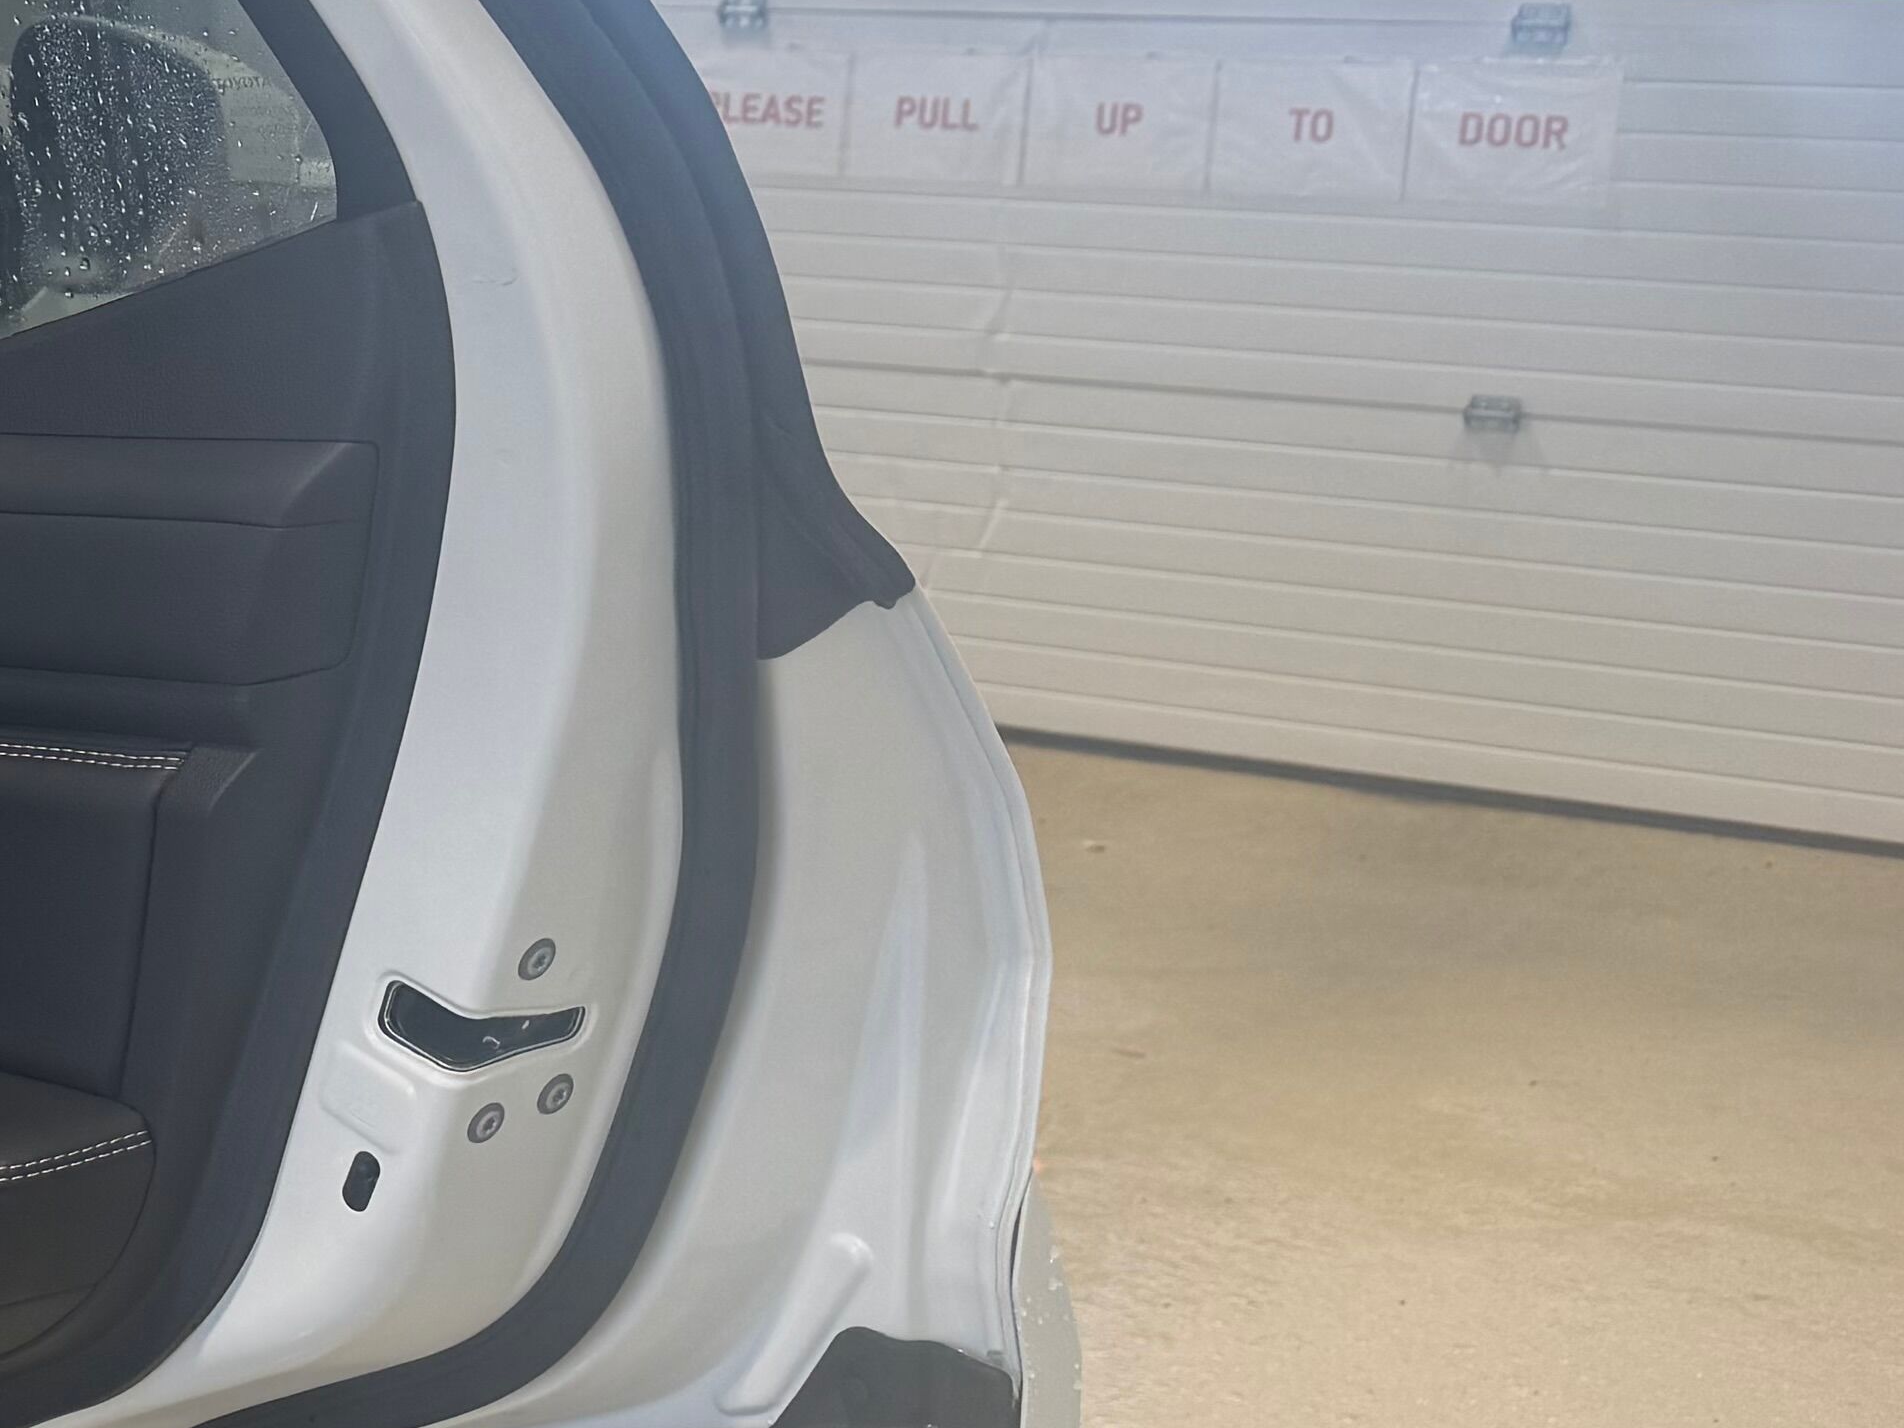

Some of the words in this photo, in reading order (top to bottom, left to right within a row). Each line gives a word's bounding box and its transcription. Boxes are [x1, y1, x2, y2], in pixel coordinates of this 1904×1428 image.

[893, 97, 978, 132] PULL
[1095, 102, 1143, 137] UP
[1288, 108, 1334, 143] TO
[1457, 112, 1569, 150] DOOR
